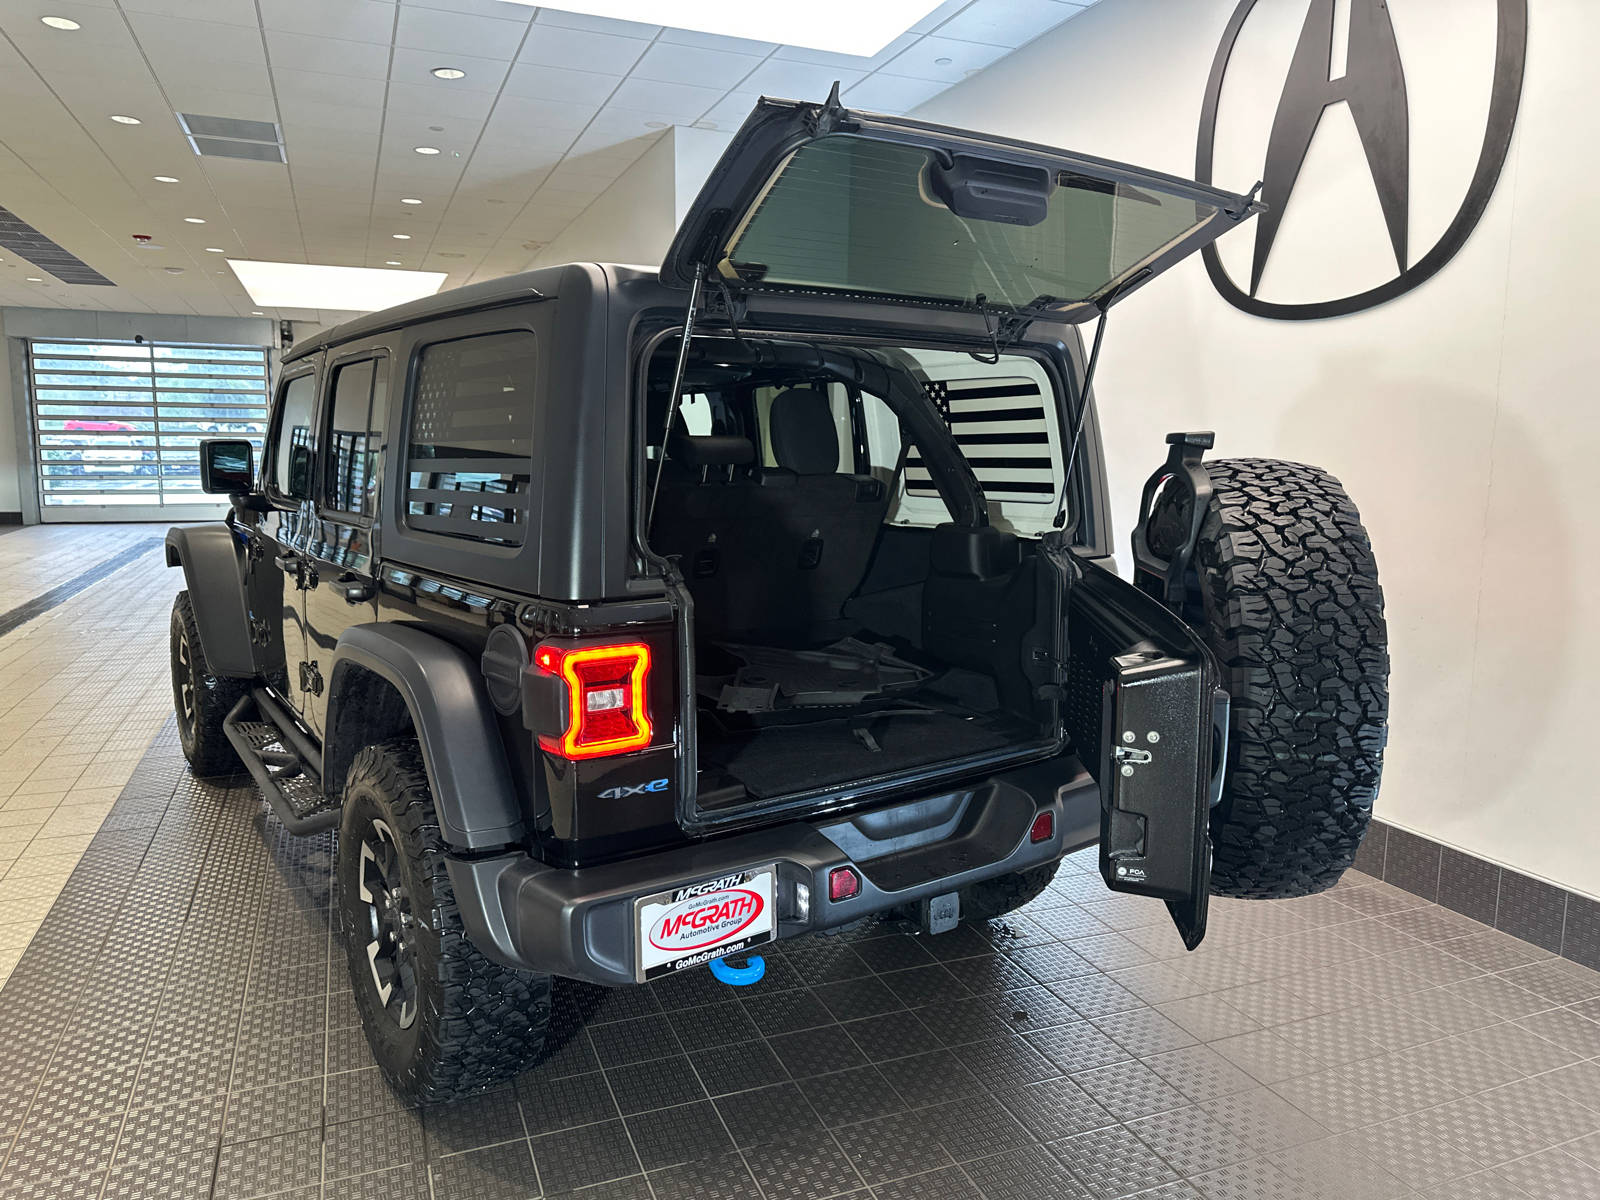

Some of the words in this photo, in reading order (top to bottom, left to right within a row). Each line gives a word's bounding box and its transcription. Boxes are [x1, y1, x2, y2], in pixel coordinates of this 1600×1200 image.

[687, 894, 730, 910] GoMcGrath.com
[679, 923, 720, 941] Automotive
[720, 917, 743, 928] Group
[675, 941, 745, 970] GoMcGrath.com
